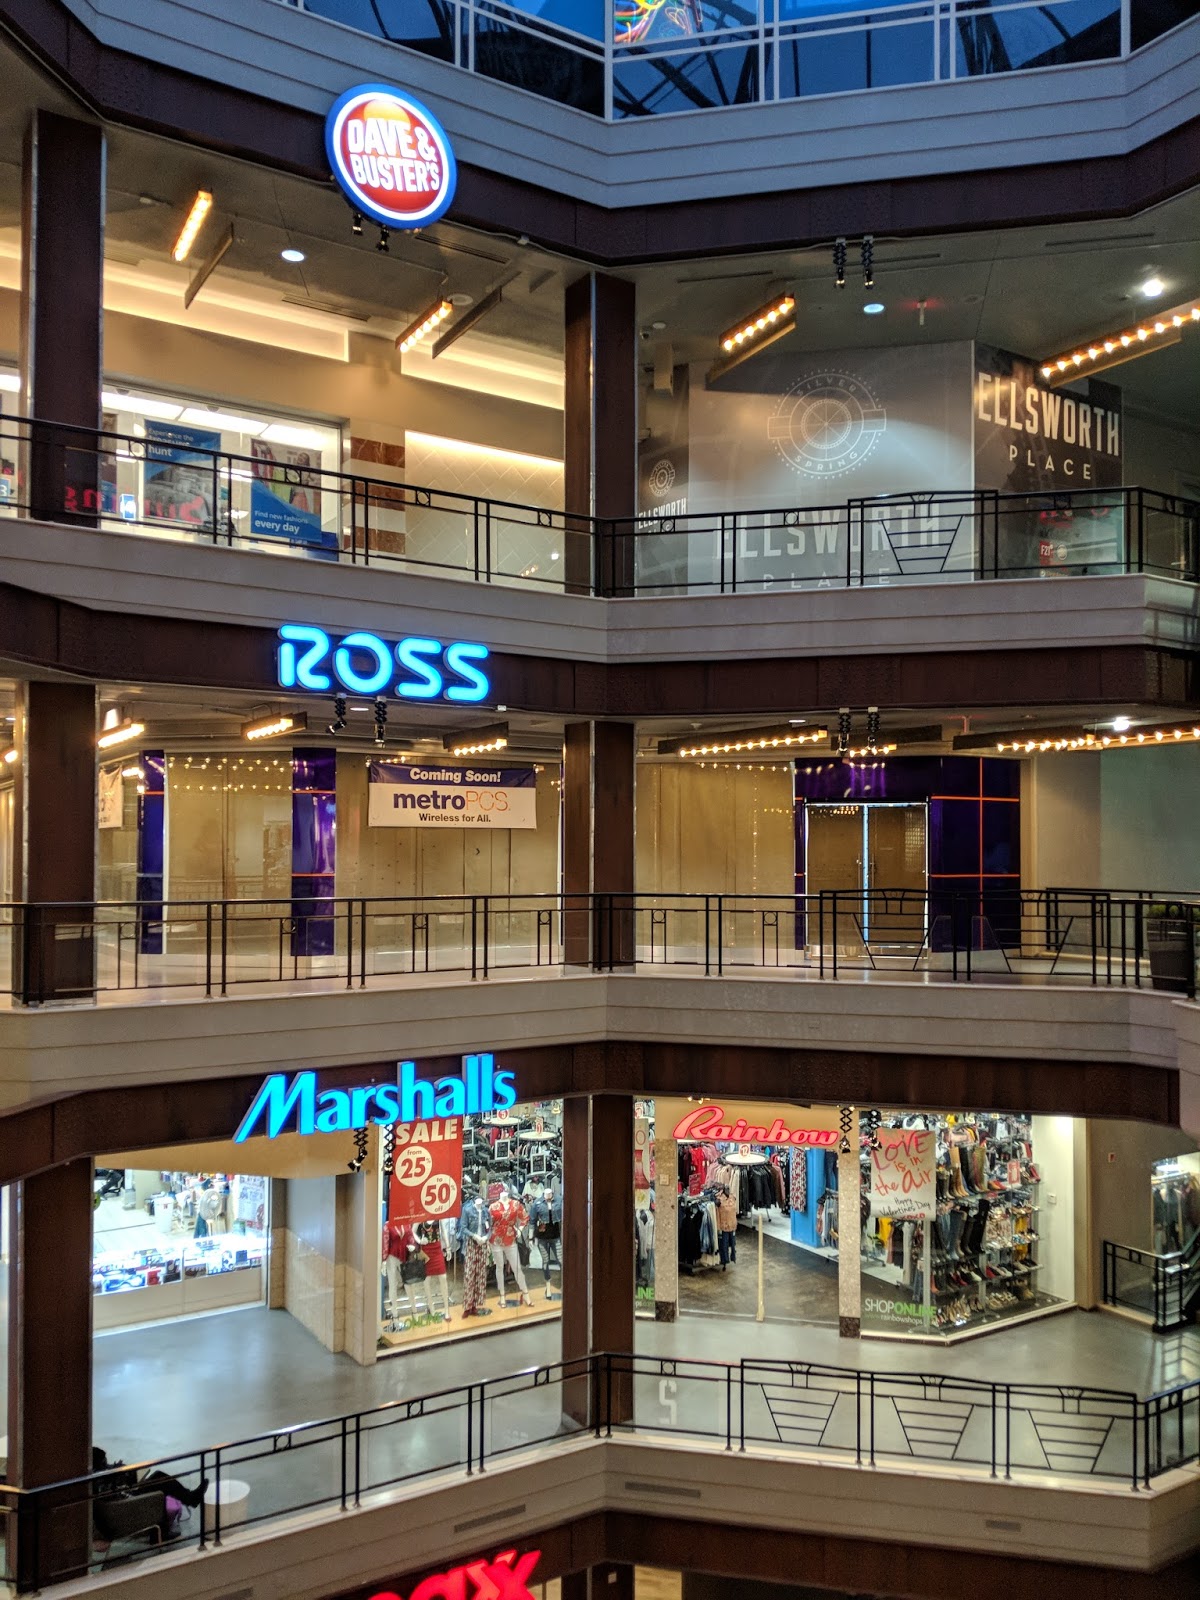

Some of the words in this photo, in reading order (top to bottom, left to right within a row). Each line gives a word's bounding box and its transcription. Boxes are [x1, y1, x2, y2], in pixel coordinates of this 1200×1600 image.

[347, 117, 417, 159] DAVE
[414, 126, 438, 162] &
[349, 153, 440, 192] BUSTER'S
[797, 376, 857, 396] SILVER
[978, 371, 1119, 457] ELLSWORTH
[148, 445, 172, 457] hunt
[794, 451, 858, 471] SPRING
[1009, 444, 1091, 480] PLACE
[254, 510, 269, 518] Find
[269, 513, 283, 521] new
[254, 519, 281, 532] every
[282, 523, 300, 535] day
[715, 502, 940, 560] ELLSWORTH
[277, 623, 491, 702] ROSS
[409, 767, 463, 783] Coming
[465, 769, 502, 783] Soon!
[419, 813, 460, 823] Wireless
[462, 814, 476, 823] for
[476, 814, 492, 823] All.
[232, 1053, 518, 1144] Marshalls
[395, 1118, 459, 1146] SALE
[672, 1105, 840, 1146] Rainbow
[875, 1174, 899, 1197] the
